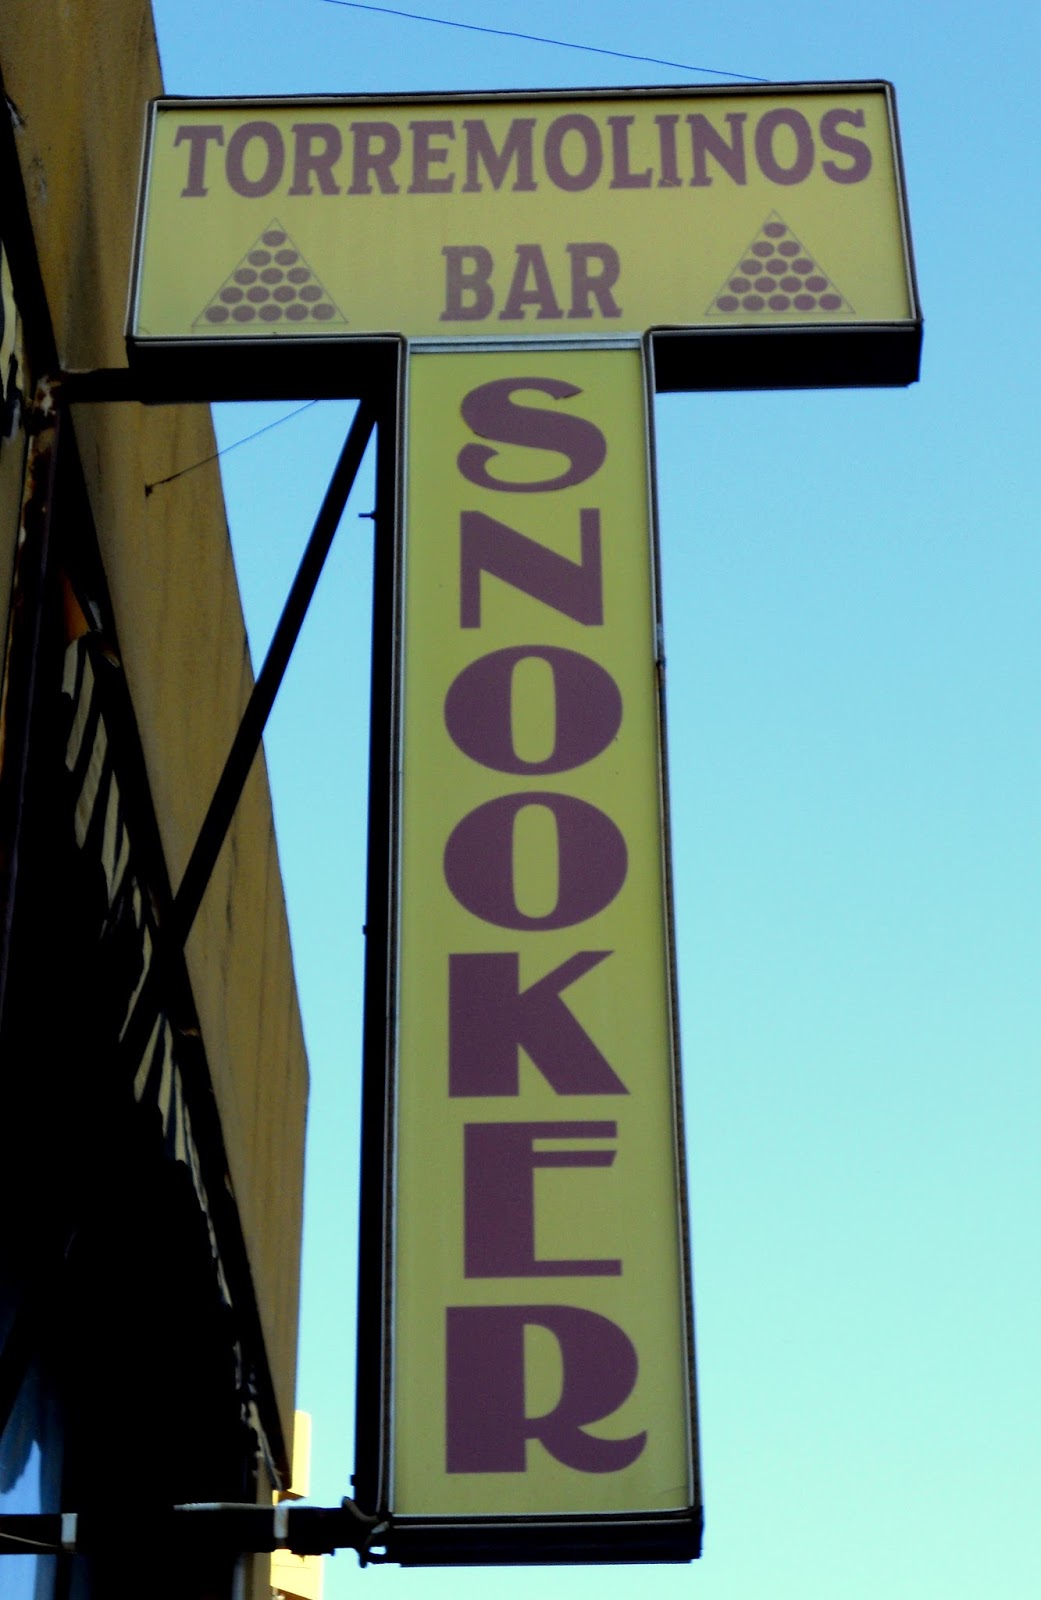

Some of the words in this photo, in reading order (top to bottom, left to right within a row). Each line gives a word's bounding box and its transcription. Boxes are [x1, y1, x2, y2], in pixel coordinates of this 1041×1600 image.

[174, 108, 872, 198] TORREMOLINOS
[440, 242, 622, 322] BAR
[444, 377, 648, 1475] SNOOKER
